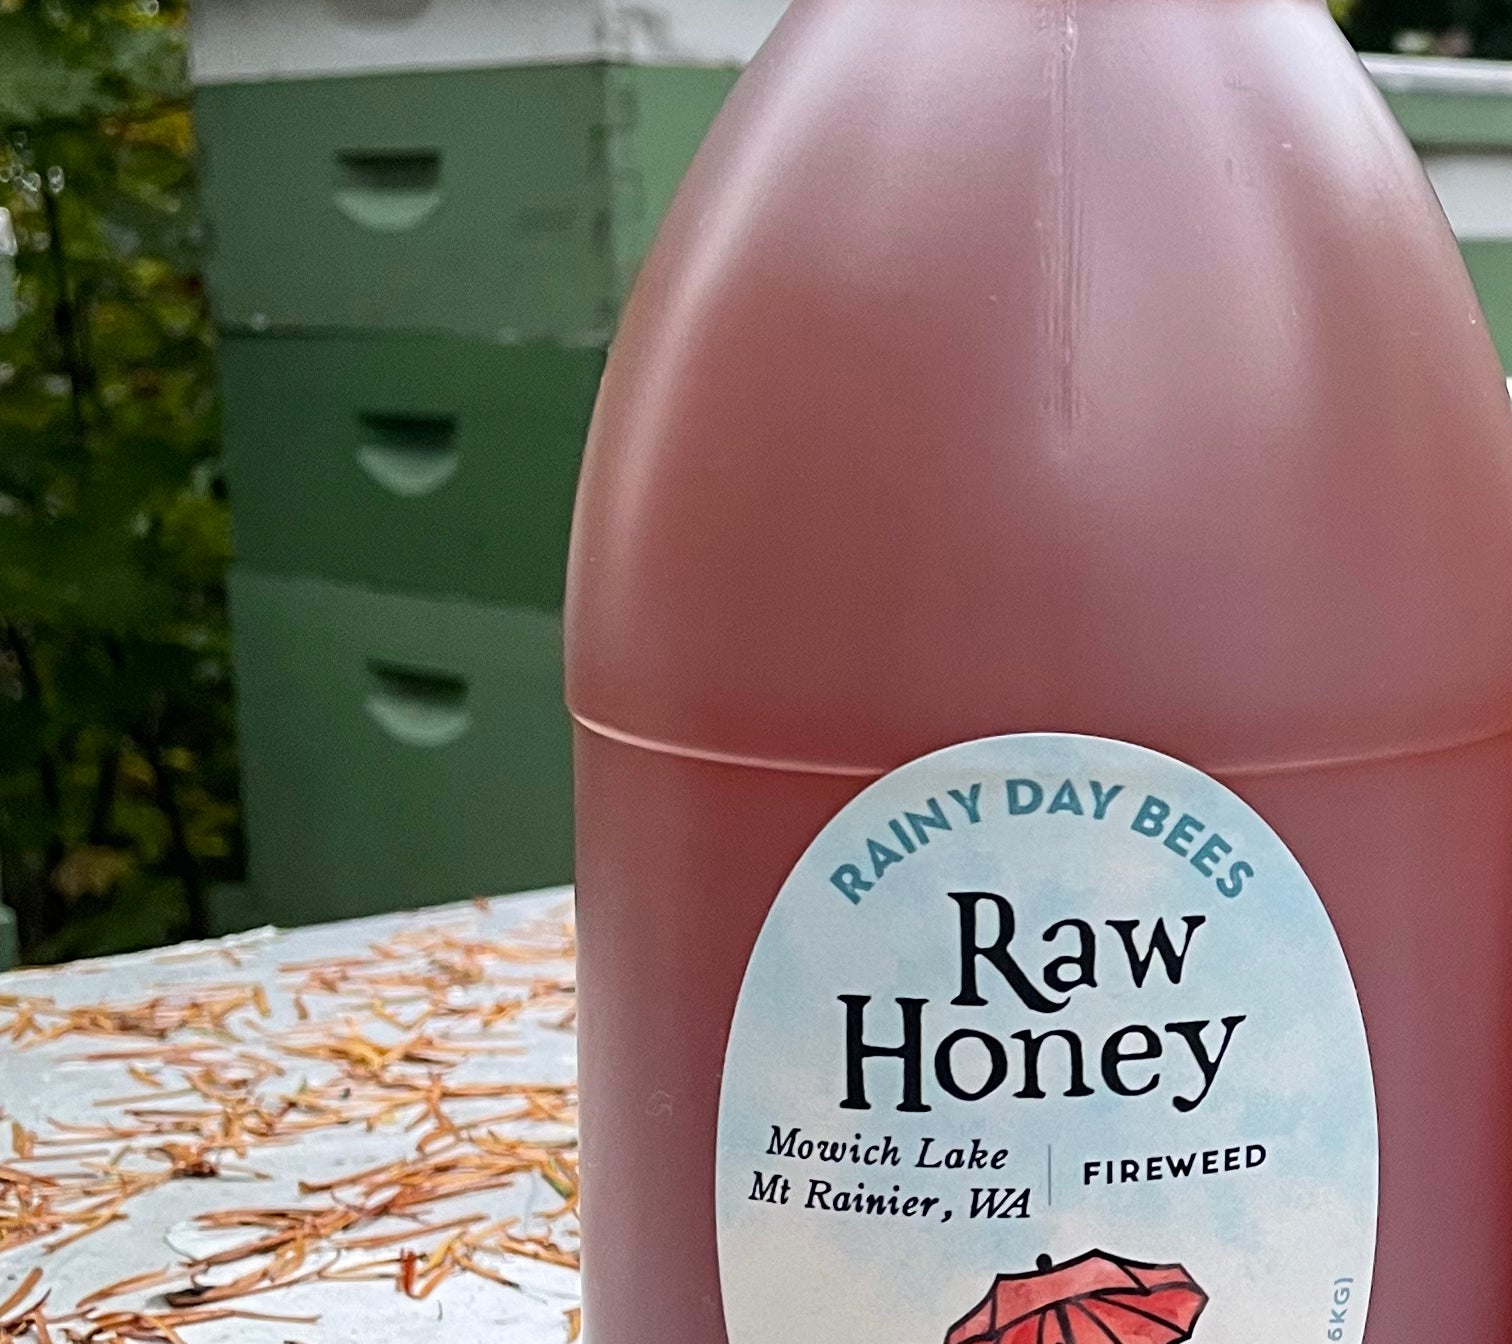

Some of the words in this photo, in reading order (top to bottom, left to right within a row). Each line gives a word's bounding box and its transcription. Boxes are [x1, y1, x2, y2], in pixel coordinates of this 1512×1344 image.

[829, 782, 984, 905] RAINY
[1005, 778, 1125, 821] DAY
[1130, 795, 1255, 899] BEES
[947, 892, 1206, 1014] Raw
[837, 994, 1247, 1113] Honey
[765, 1124, 901, 1166] Mowich
[918, 1137, 1009, 1170] Lake
[1083, 1144, 1267, 1186] FIREWEED
[748, 1171, 792, 1206] Mt
[804, 1180, 953, 1222] Rainier,
[969, 1189, 1032, 1219] WA
